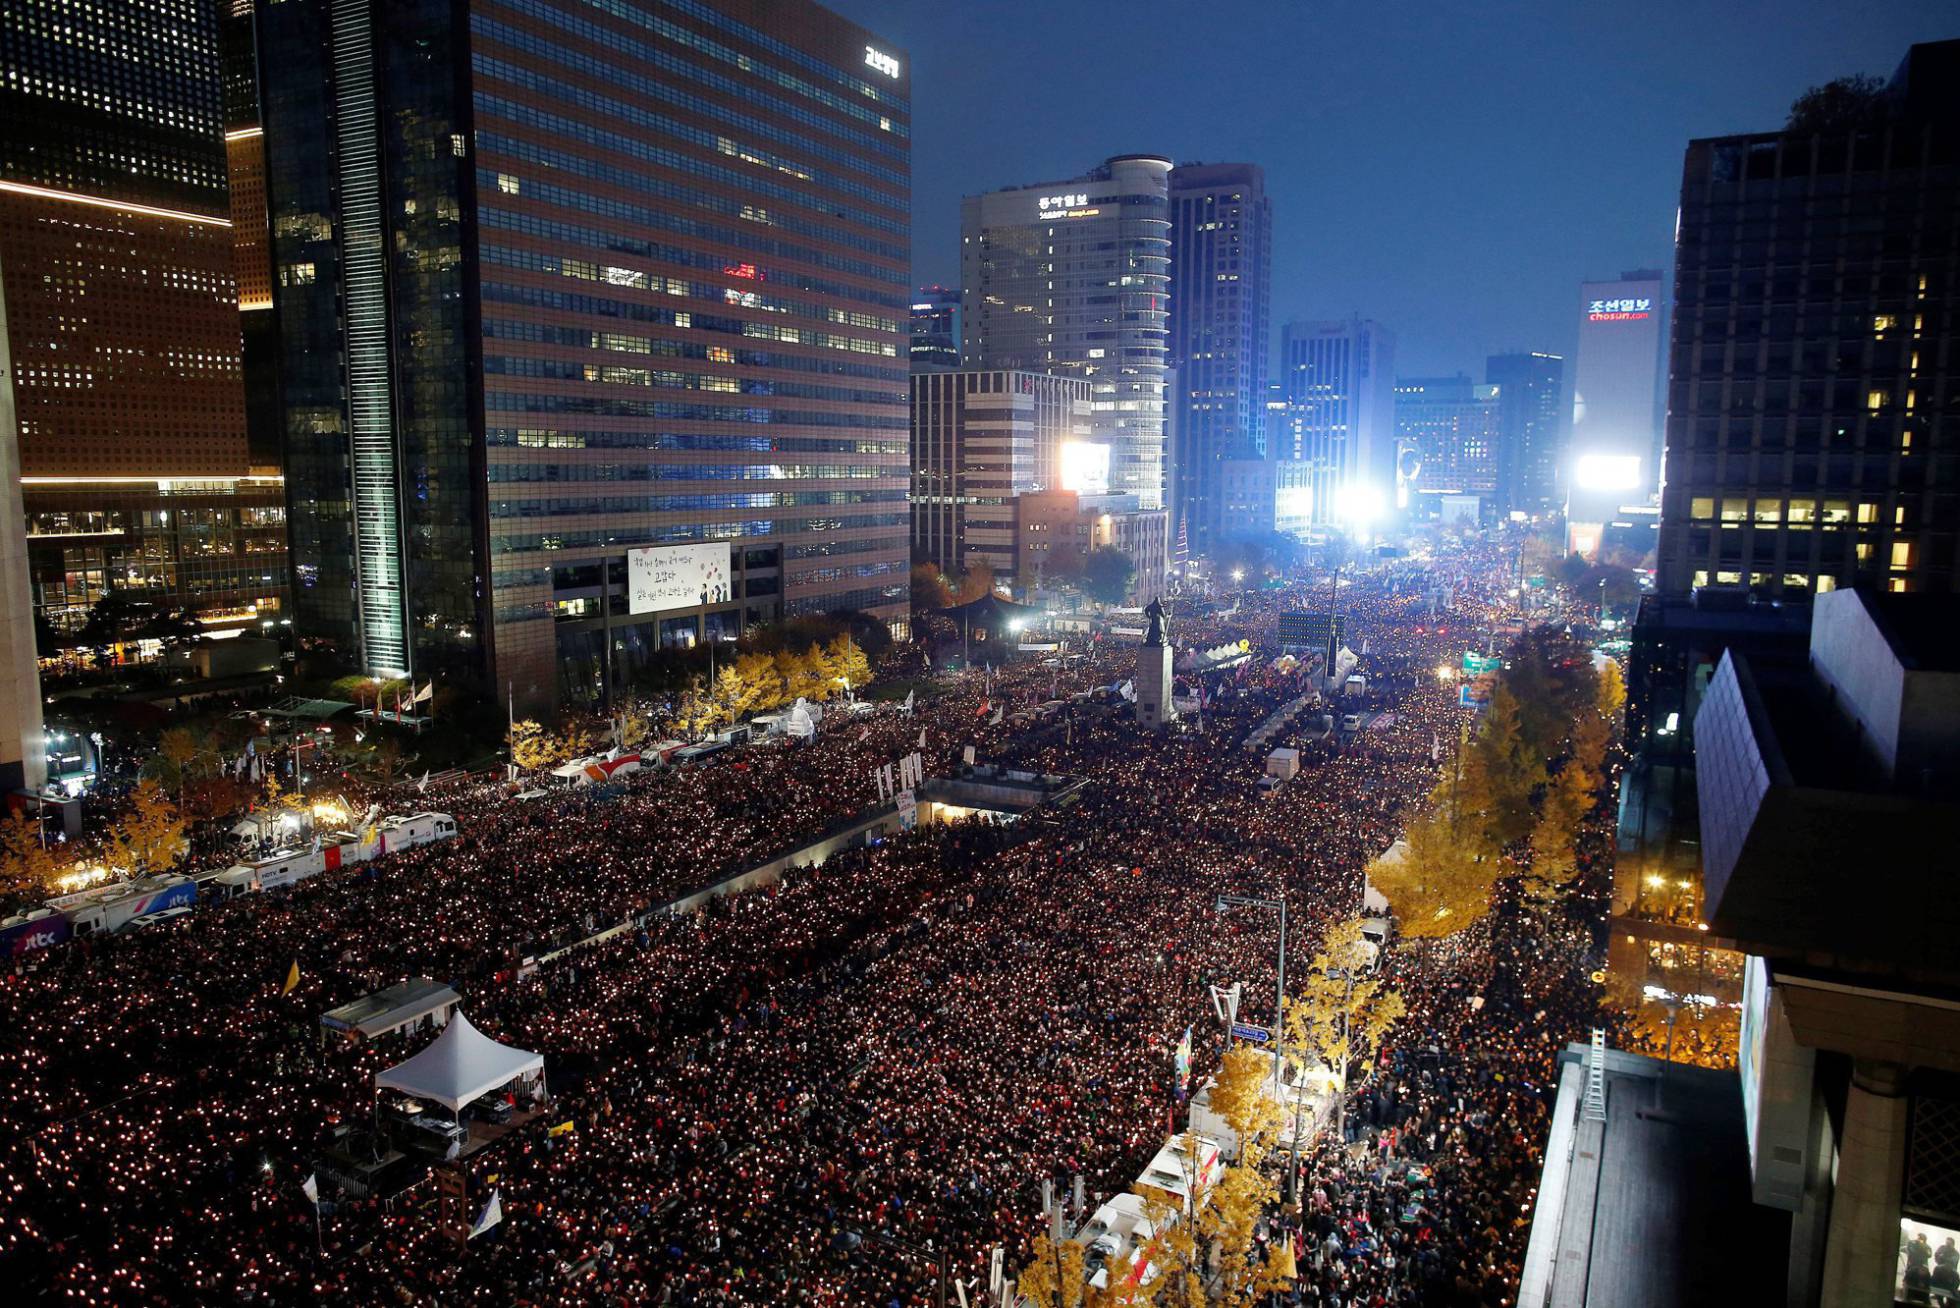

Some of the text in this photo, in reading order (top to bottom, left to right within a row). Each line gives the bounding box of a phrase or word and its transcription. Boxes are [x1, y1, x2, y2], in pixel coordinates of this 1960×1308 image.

[1038, 194, 1088, 210] 동아일보
[1588, 299, 1651, 313] 조선일보
[1590, 312, 1649, 321] chosun.com
